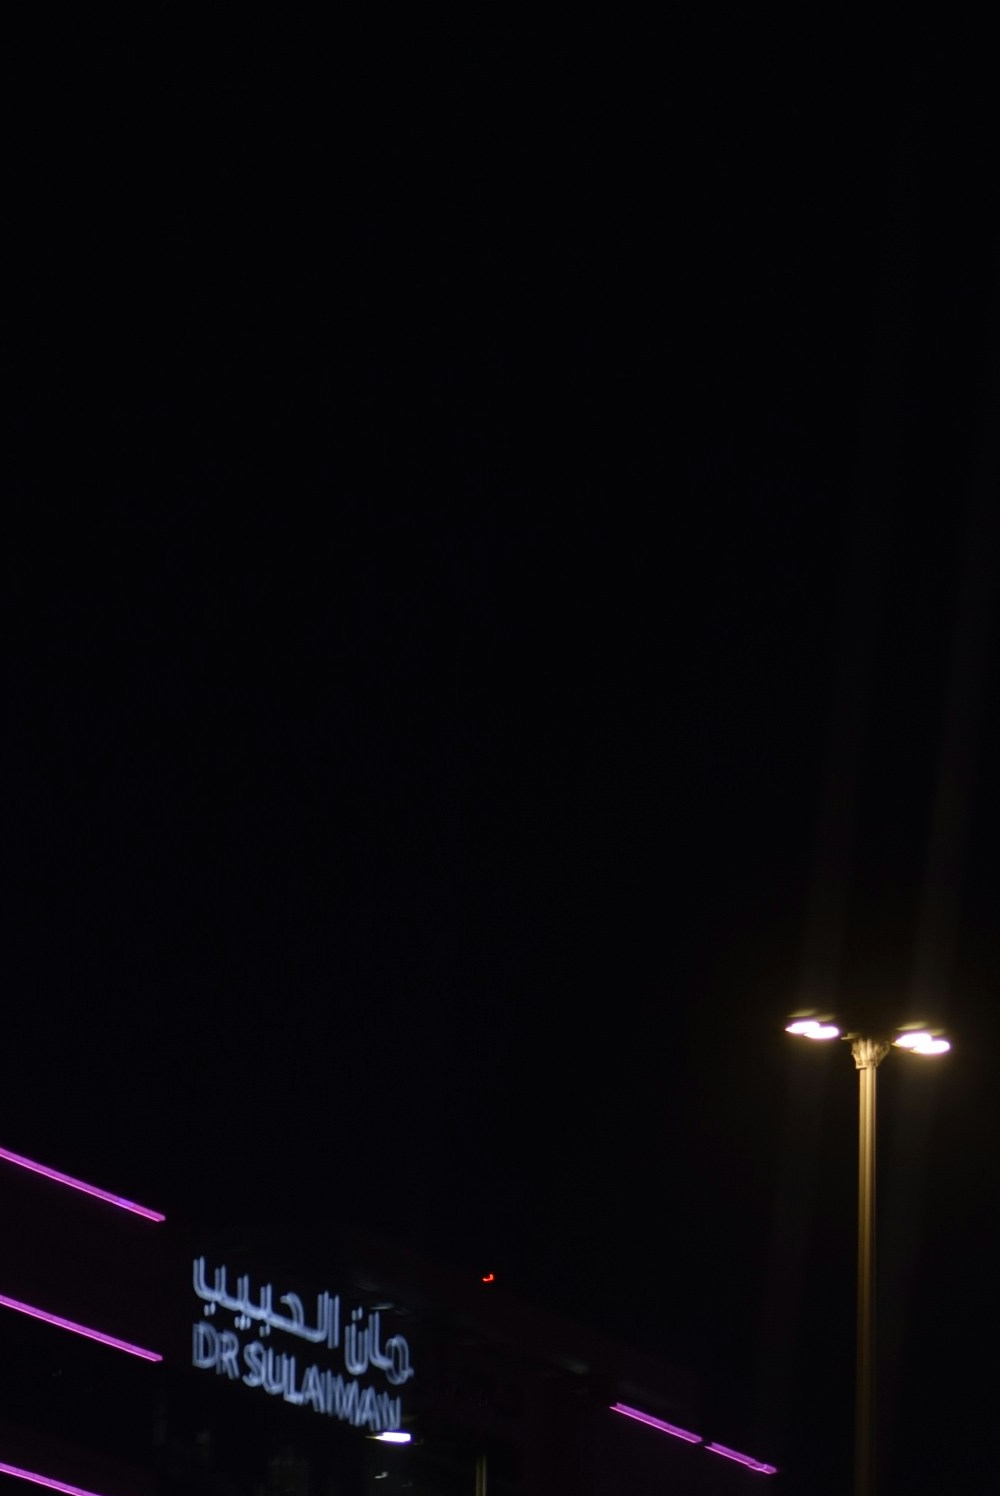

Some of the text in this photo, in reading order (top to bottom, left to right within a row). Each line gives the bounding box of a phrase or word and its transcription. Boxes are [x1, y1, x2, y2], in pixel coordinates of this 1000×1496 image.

[193, 1256, 339, 1349] الحبيب
[192, 1321, 401, 1431] DR SULAIMAN
